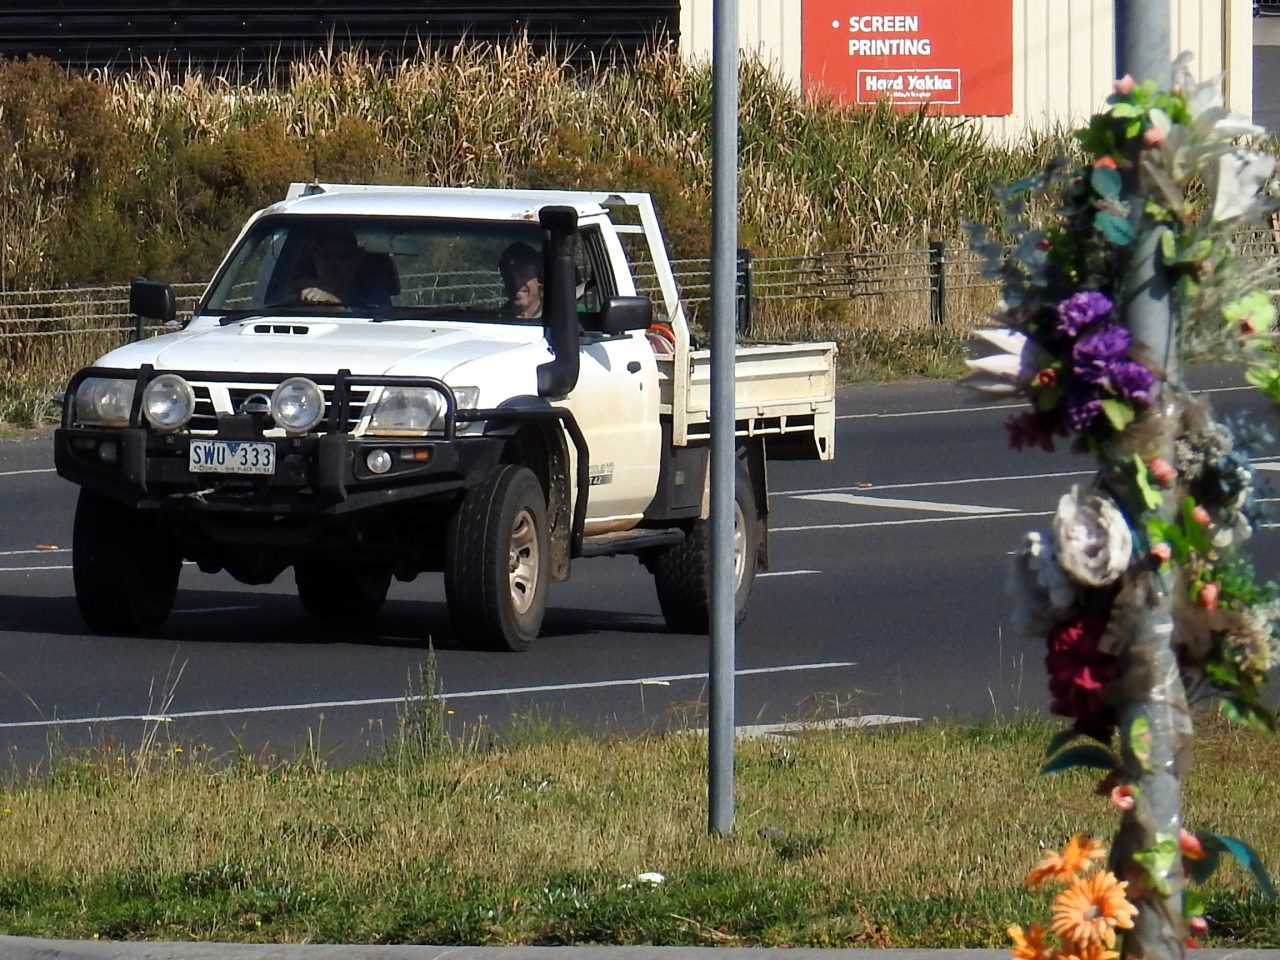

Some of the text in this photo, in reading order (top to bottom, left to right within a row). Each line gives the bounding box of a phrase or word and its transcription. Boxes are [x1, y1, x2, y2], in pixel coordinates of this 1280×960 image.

[849, 15, 919, 33] SCREEN
[848, 38, 931, 56] PRINTING
[865, 74, 953, 91] Hard Yakka
[192, 445, 271, 467] SWU 333
